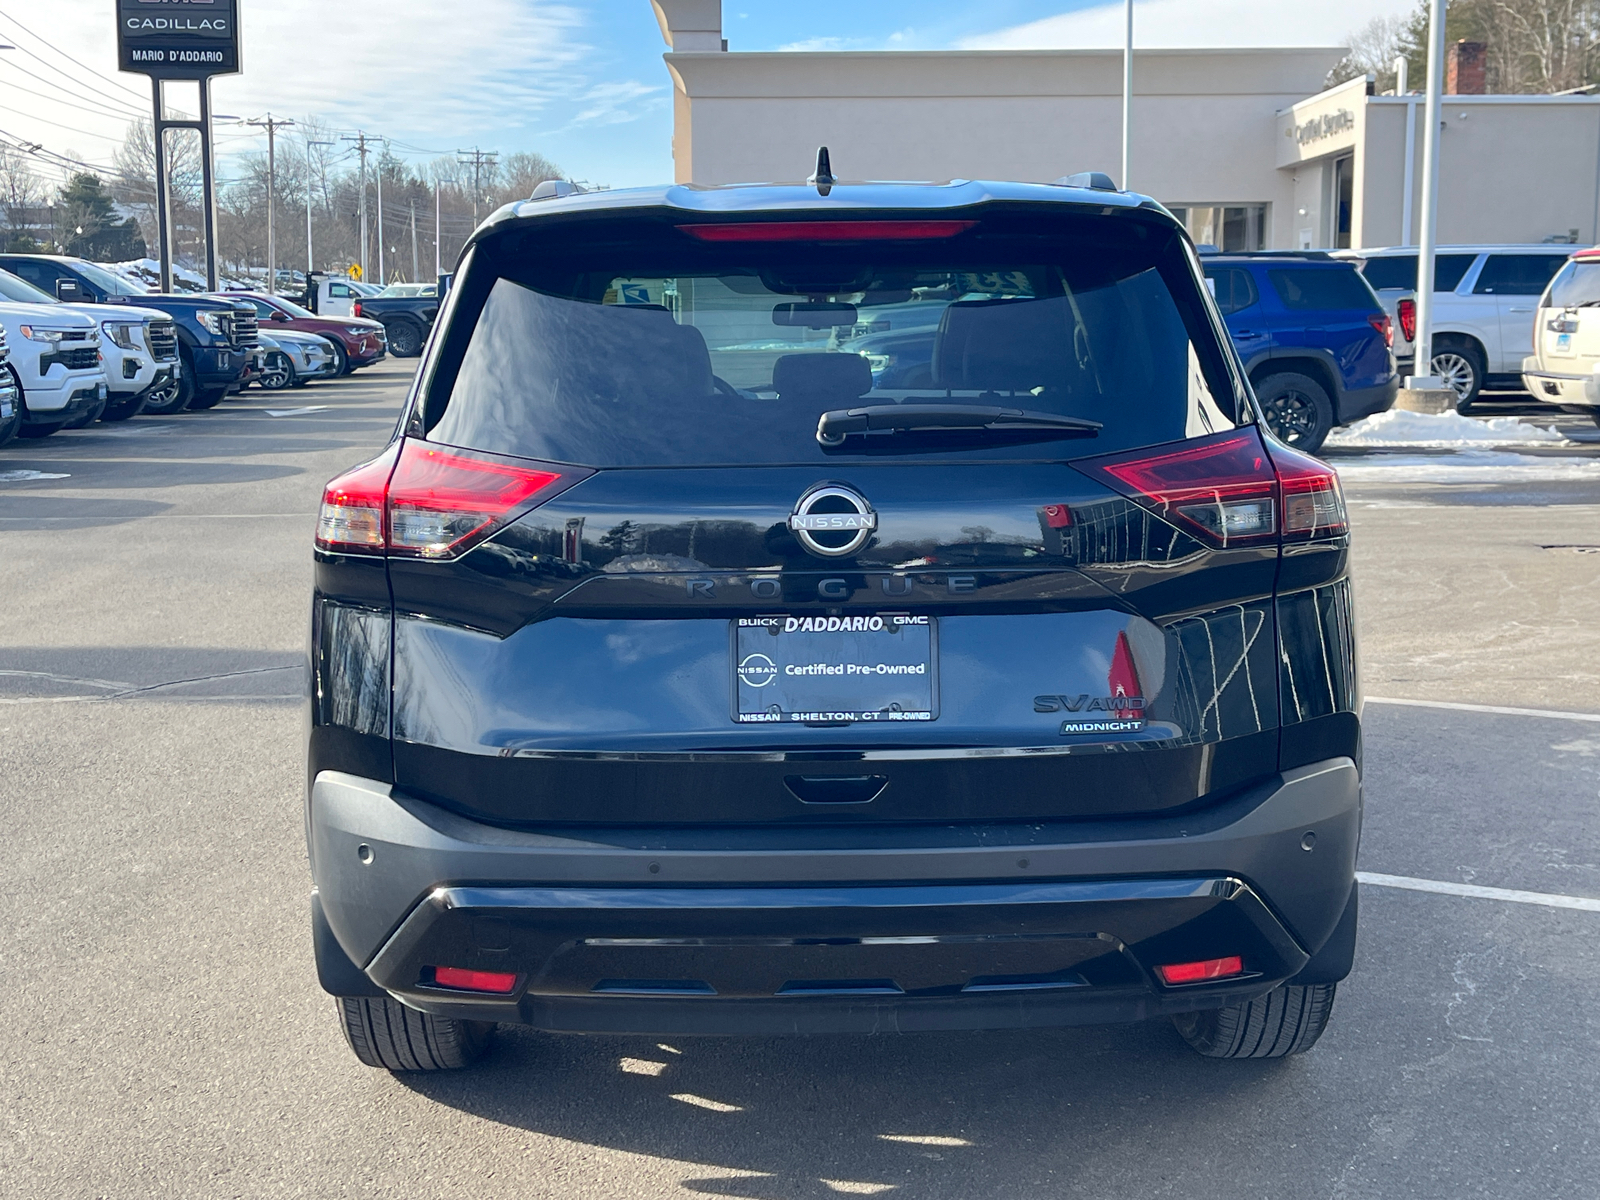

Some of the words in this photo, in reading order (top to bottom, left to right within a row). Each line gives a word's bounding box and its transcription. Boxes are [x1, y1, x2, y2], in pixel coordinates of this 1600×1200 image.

[126, 18, 226, 30] CADILLAC
[132, 50, 165, 61] MARIO
[169, 50, 223, 62] D'ADDARIO
[794, 515, 874, 528] NISSAN
[686, 576, 976, 599] ROGUE
[738, 618, 779, 626] BUICK
[784, 616, 884, 633] D'ADDARIO
[893, 615, 929, 625] GMC
[737, 666, 778, 674] NISSAN
[785, 663, 844, 675] Certified
[846, 663, 925, 675] Pre-Owned
[1034, 694, 1089, 713] SV
[1086, 696, 1148, 712] AWD
[739, 713, 781, 722] NISSAN
[791, 712, 859, 722] SHELTON,
[861, 712, 881, 720] CT
[1065, 721, 1142, 732] MIDNIGHT
